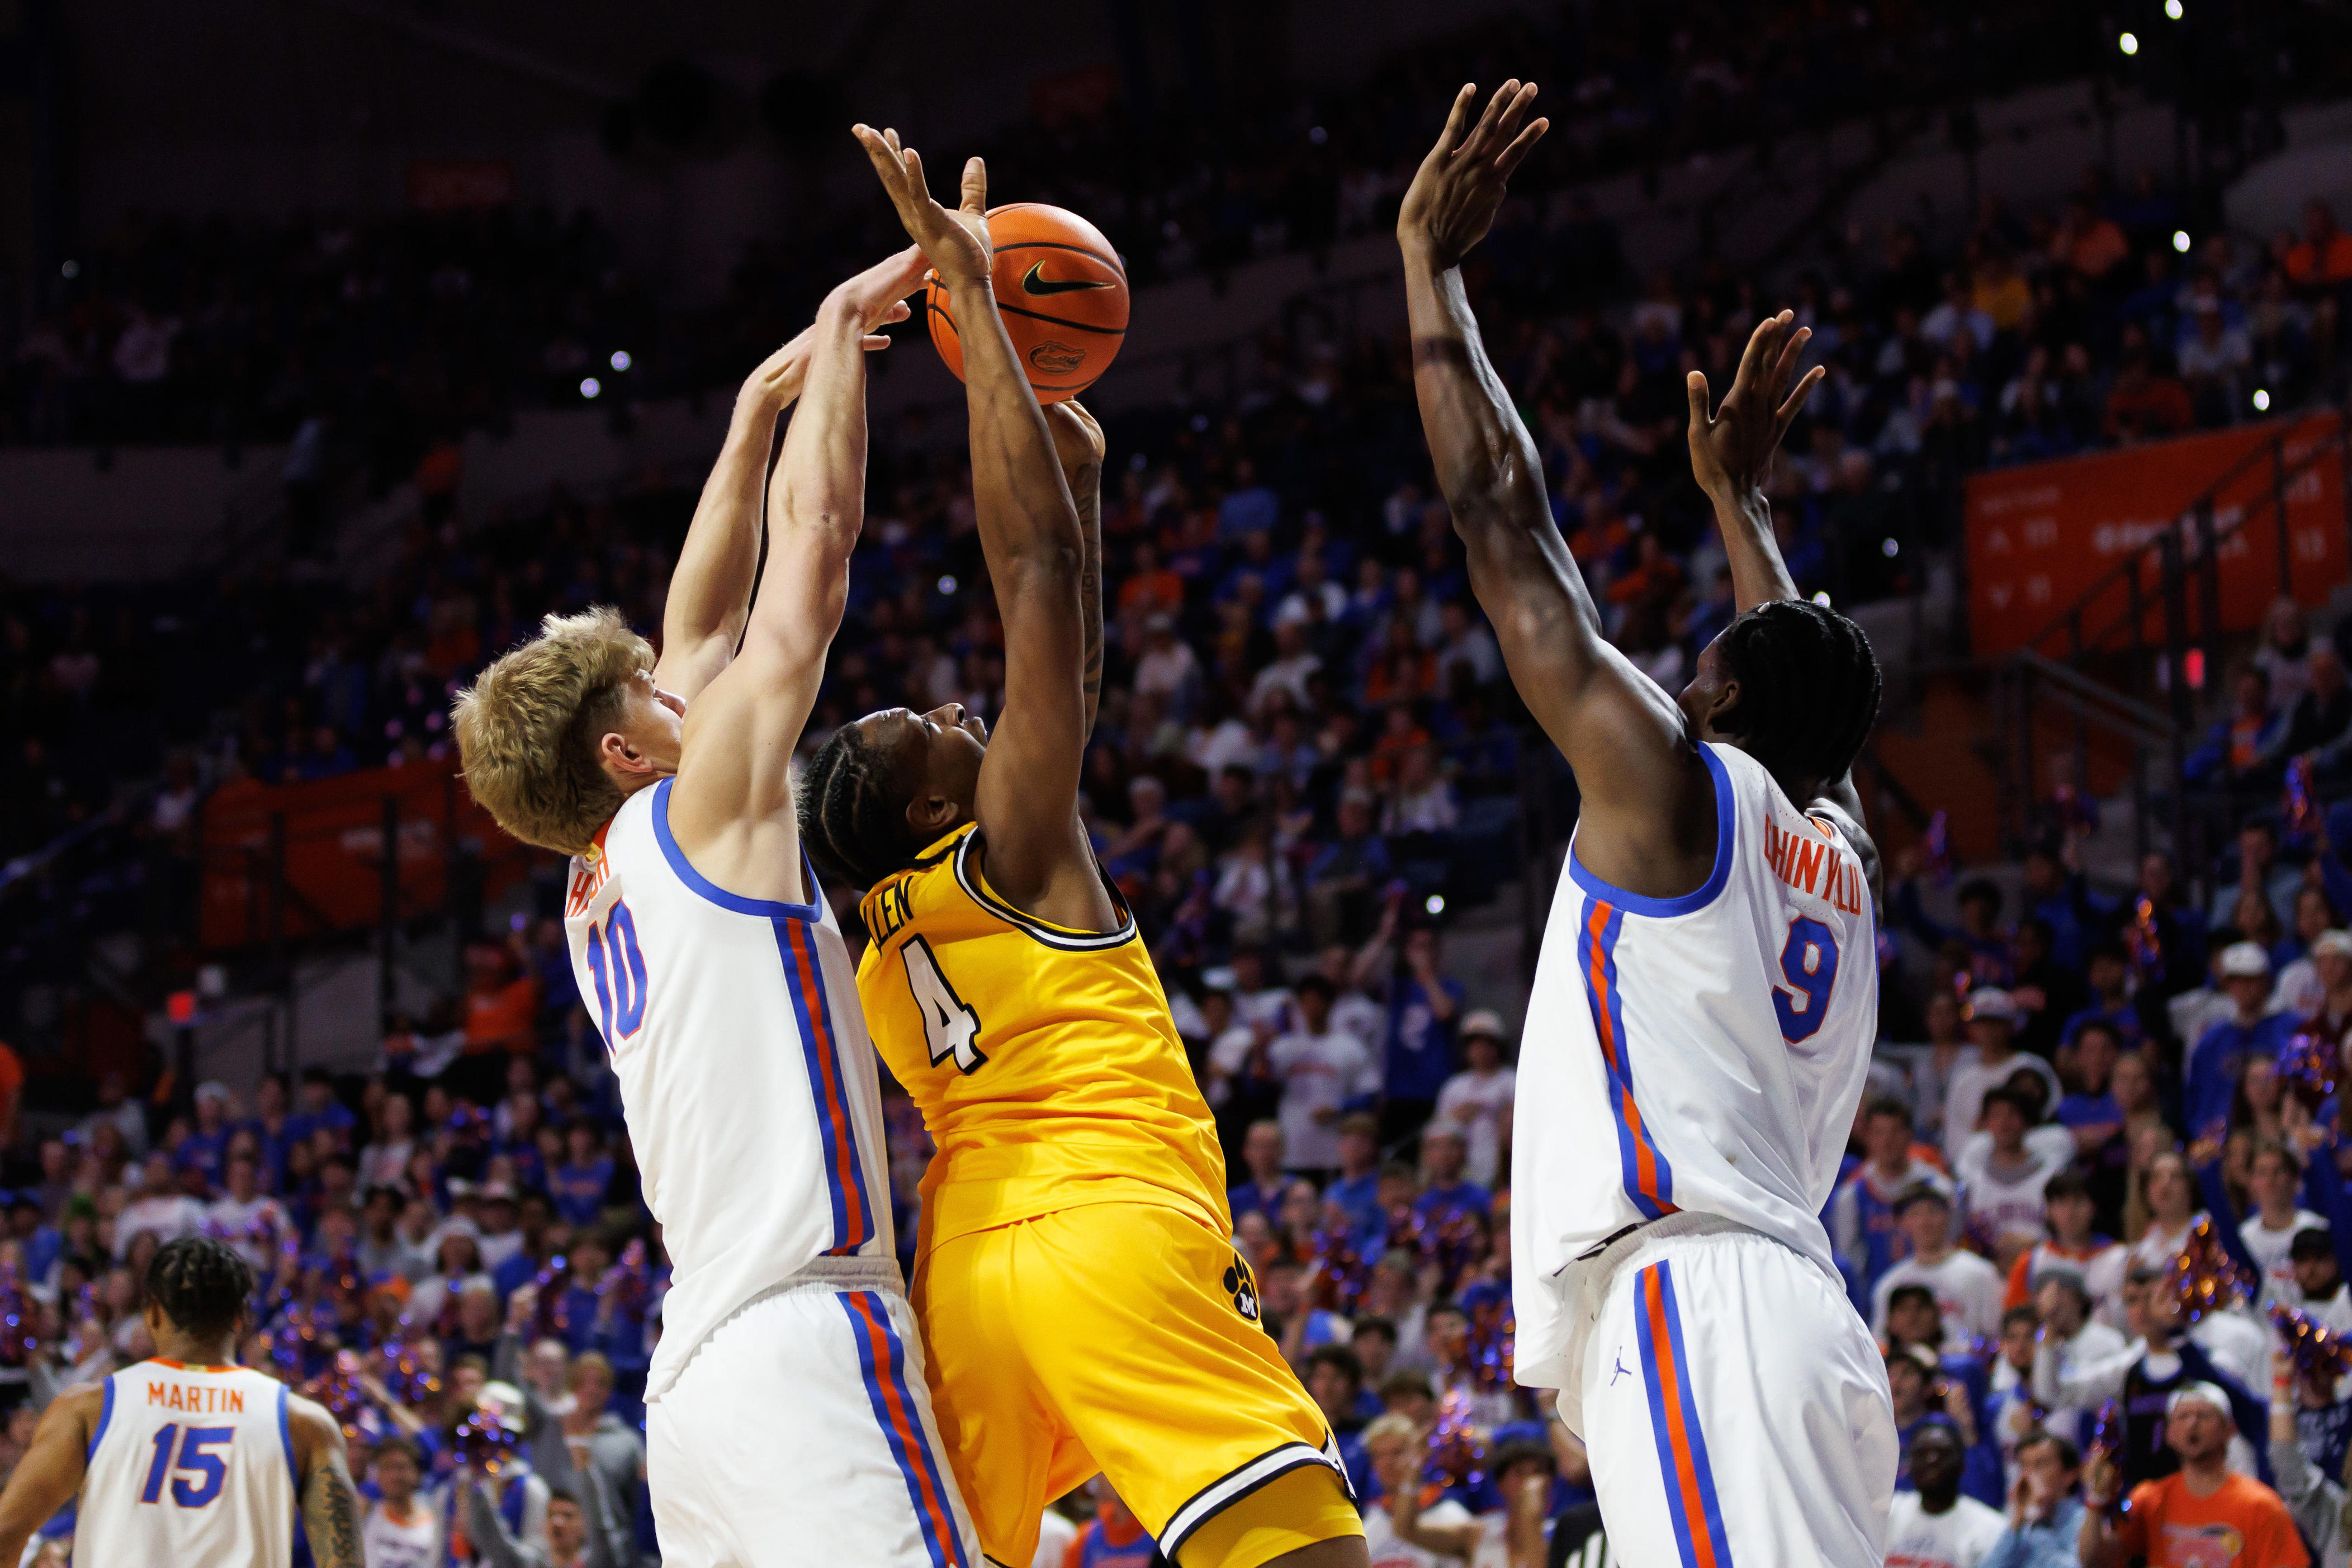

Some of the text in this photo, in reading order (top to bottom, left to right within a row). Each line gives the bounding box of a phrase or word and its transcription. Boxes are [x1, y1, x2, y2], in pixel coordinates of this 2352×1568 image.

[1764, 813, 1861, 916] CHINYLU
[587, 899, 648, 1057] 10
[899, 933, 988, 1076] 4
[1771, 915, 1839, 1044] 9
[1239, 1292, 1256, 1318] M
[148, 1381, 244, 1413] MARTIN
[140, 1422, 236, 1509] 15
